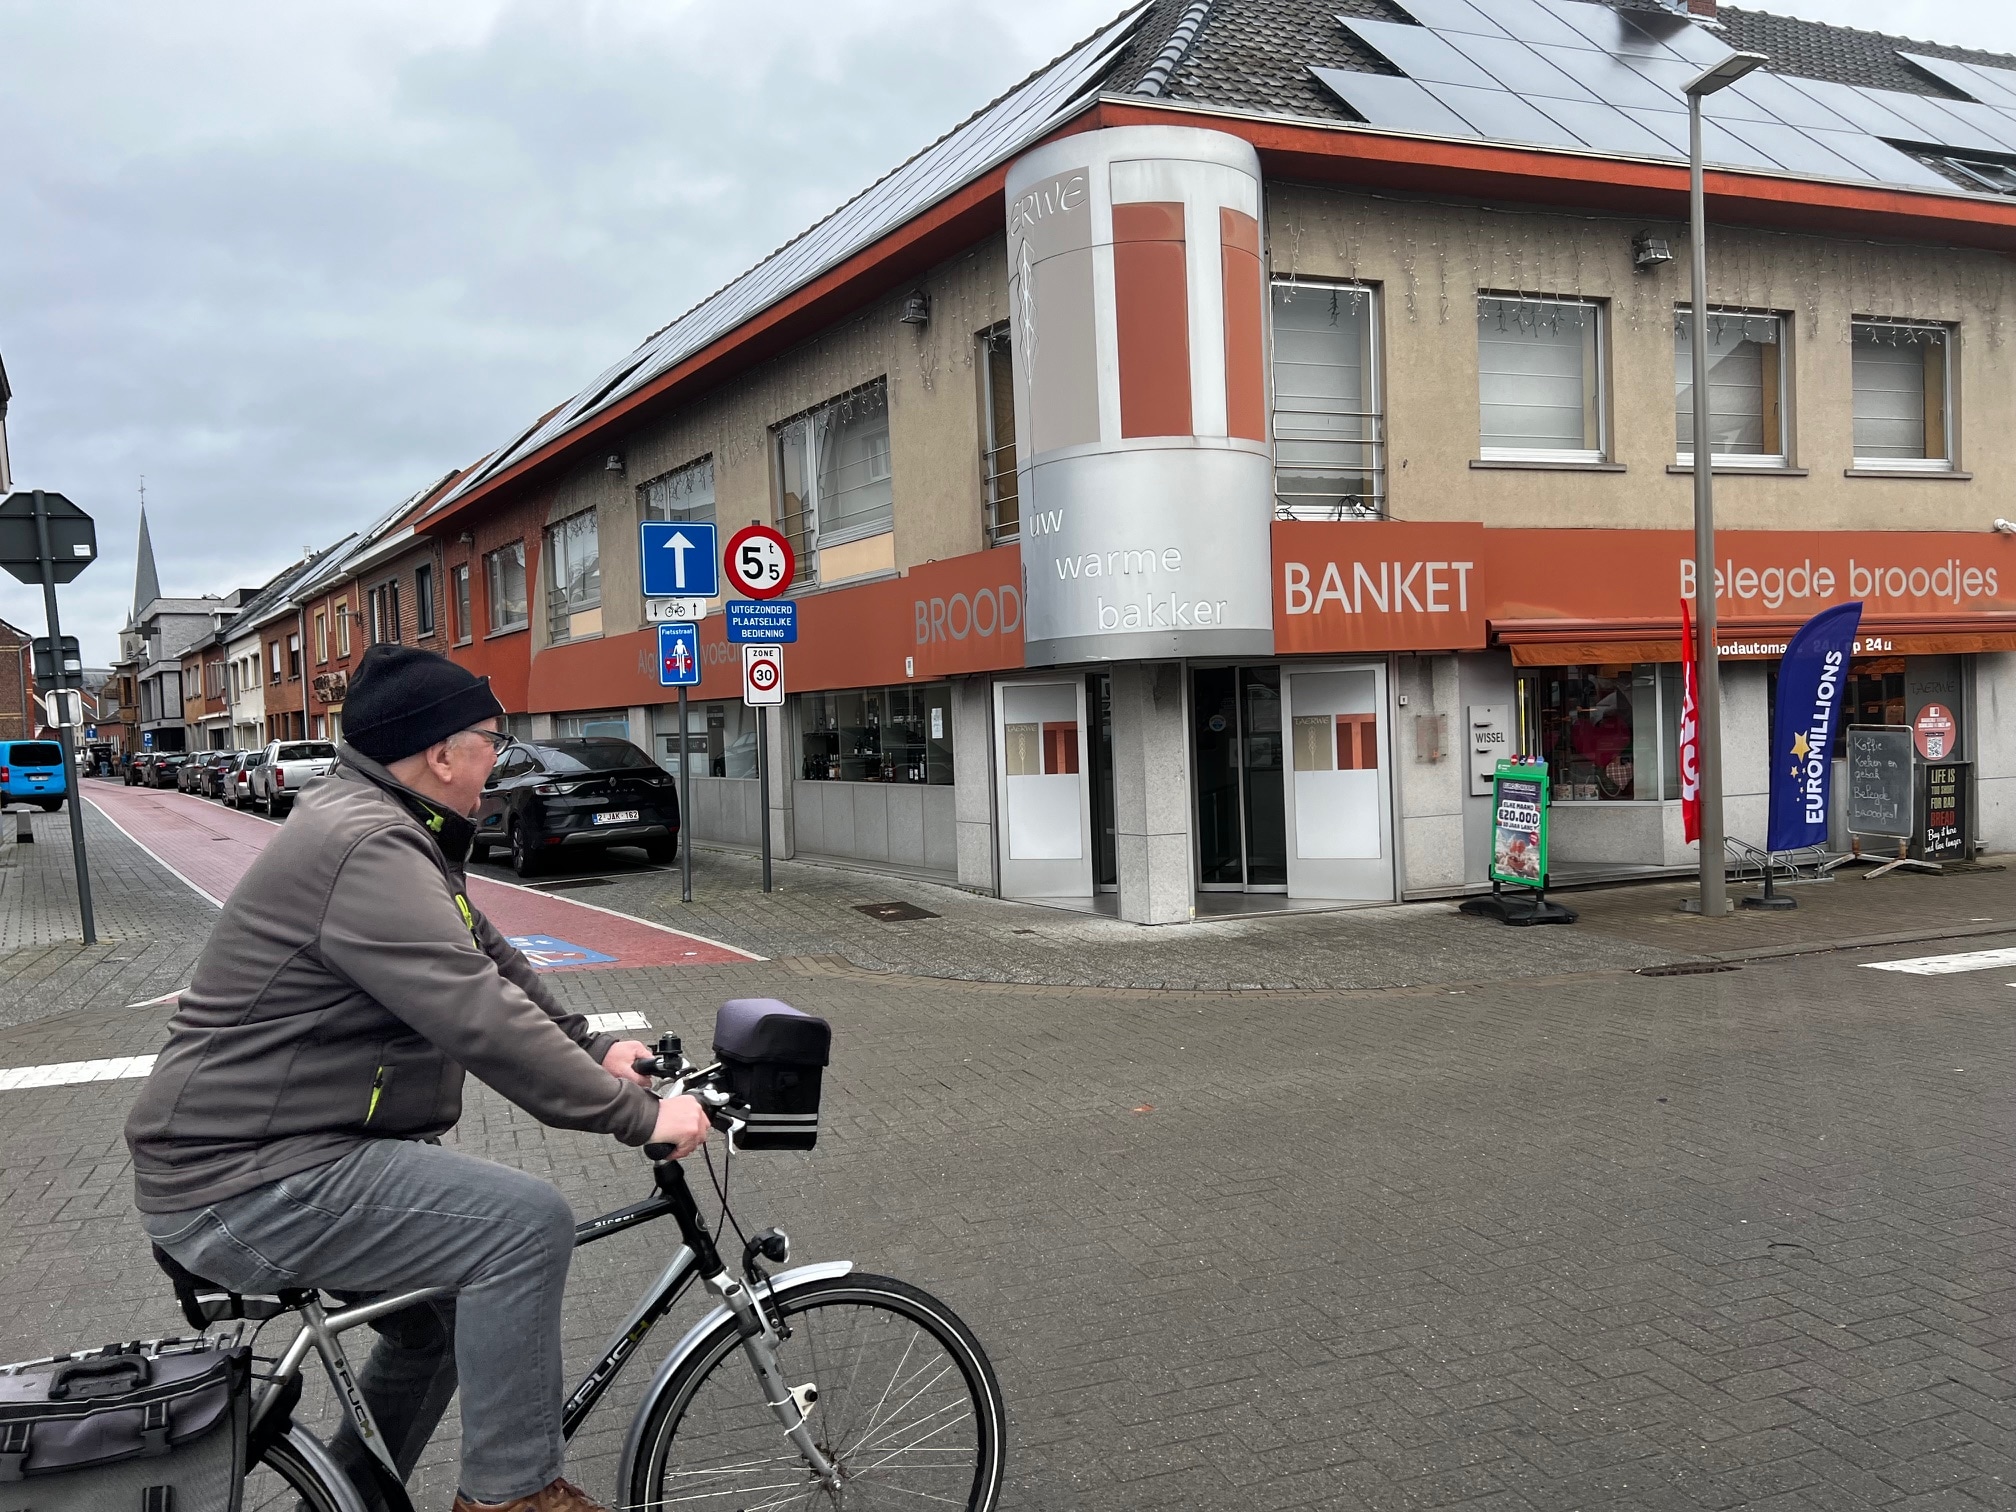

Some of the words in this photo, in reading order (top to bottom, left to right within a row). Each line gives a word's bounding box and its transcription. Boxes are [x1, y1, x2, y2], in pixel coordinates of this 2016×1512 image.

[1006, 175, 1087, 237] ERWE
[1029, 508, 1064, 538] uw
[1055, 546, 1183, 581] warme
[1284, 561, 1474, 615] BANKET
[1849, 558, 1999, 605] broodjes
[731, 605, 793, 615] UITGEZONDERD
[914, 584, 1022, 646] BROOD
[1097, 591, 1228, 631] bakker
[732, 617, 792, 627] PLAATSELIJKE
[661, 628, 693, 636] Fietsstraat
[741, 629, 785, 638] BEDIENING
[753, 649, 774, 657] ZONE
[756, 669, 773, 682] 30
[1910, 680, 1956, 695] TAERWE
[144, 733, 152, 742] P
[1475, 731, 1505, 743] WISSEL
[1805, 650, 1844, 824] EUROMILLIONS
[1853, 736, 1883, 754] Koffie
[1887, 759, 1898, 769] en
[1931, 768, 1946, 784] LIFE
[1947, 768, 1956, 783] IS
[1853, 784, 1891, 806] Belegde
[1930, 797, 1942, 809] FOR
[1943, 796, 1955, 808] BAD
[1930, 810, 1955, 827] BREAD
[1927, 828, 1940, 841] Buy
[1946, 825, 1957, 836] here
[1945, 837, 1962, 850] longer
[594, 1213, 635, 1228] Street
[573, 1319, 650, 1405] PUCH
